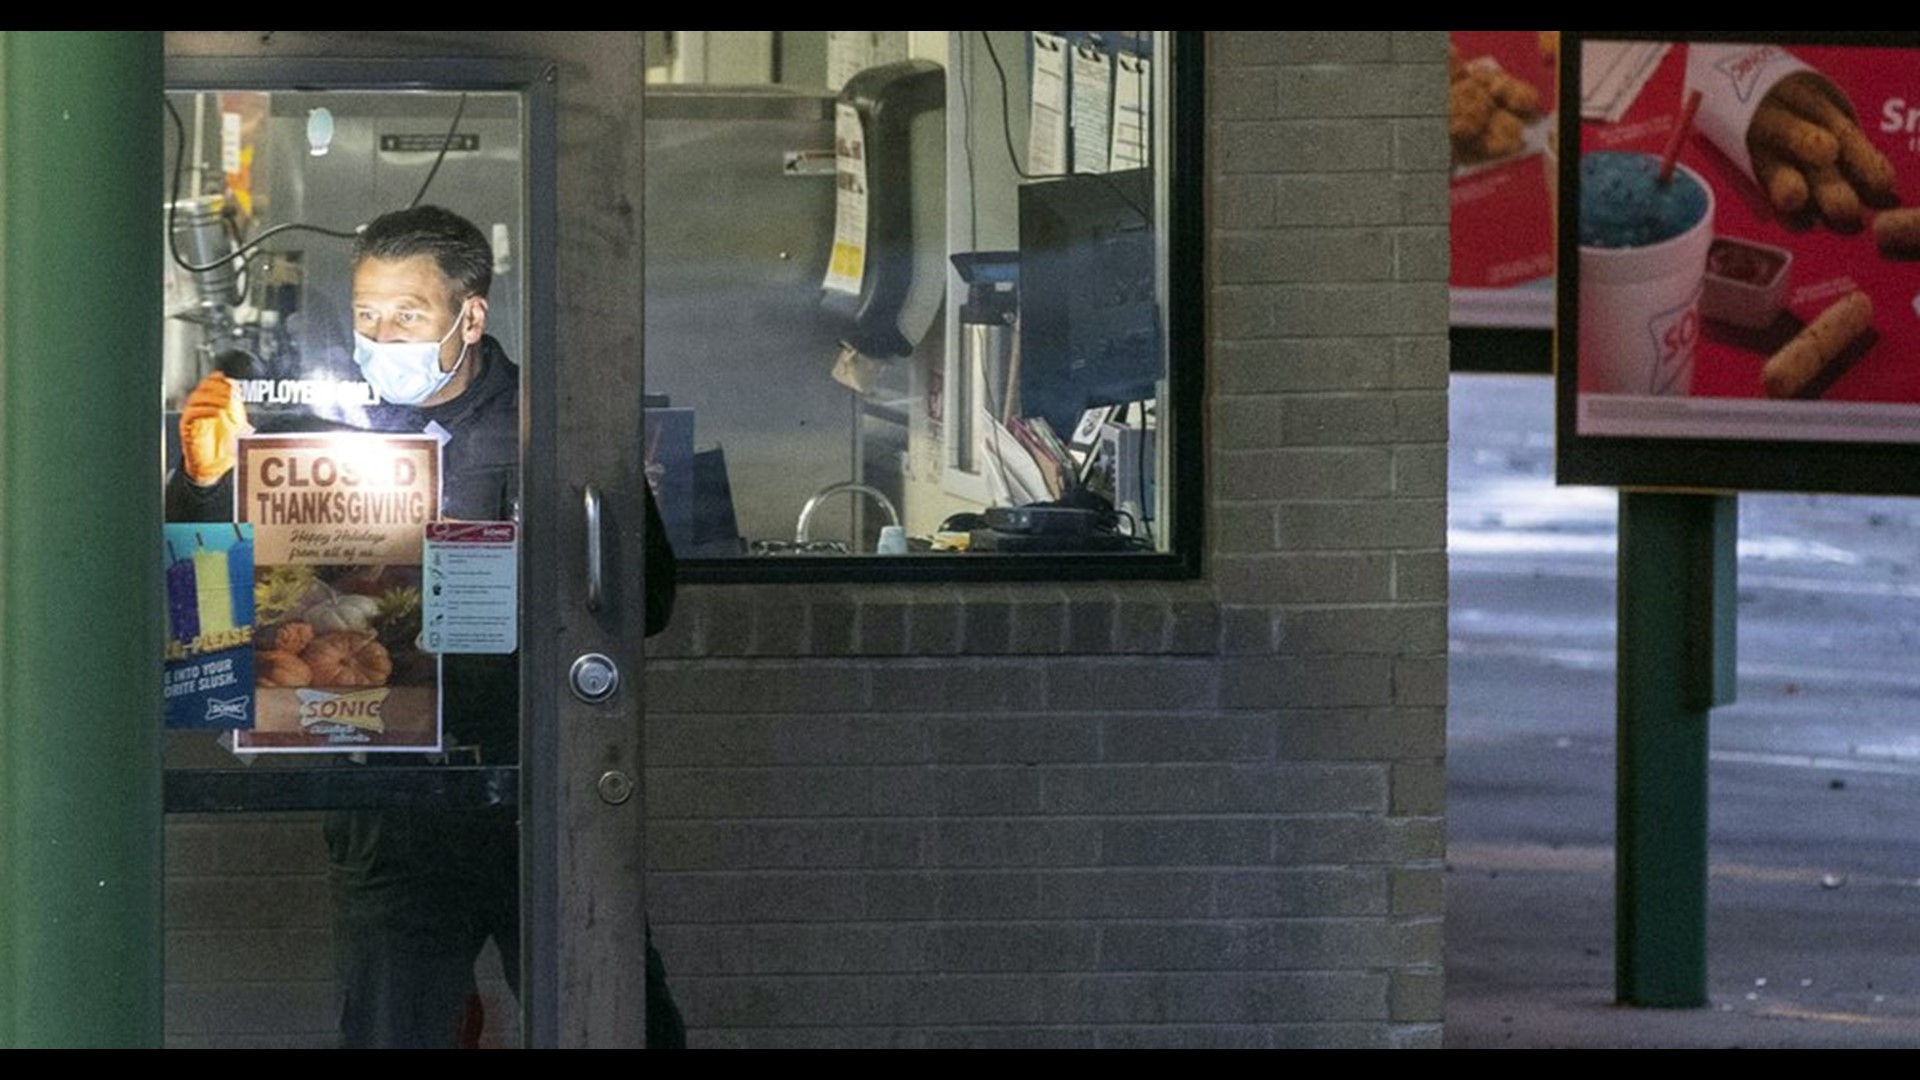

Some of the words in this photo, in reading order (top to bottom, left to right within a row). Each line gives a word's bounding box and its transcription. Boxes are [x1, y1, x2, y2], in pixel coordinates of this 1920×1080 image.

[231, 379, 335, 404] EMPLOYE
[260, 457, 416, 487] CLOSD
[257, 492, 424, 524] THANKSGIVING
[290, 528, 331, 545] Happy
[333, 528, 386, 545] Holidays
[288, 546, 320, 562] from
[323, 546, 341, 558] all
[343, 546, 357, 562] of
[173, 665, 200, 682] INTO
[202, 658, 233, 676] YOUR
[198, 672, 238, 691] SLUSH.
[212, 703, 244, 713] SONIC
[306, 700, 382, 718] SONIC
